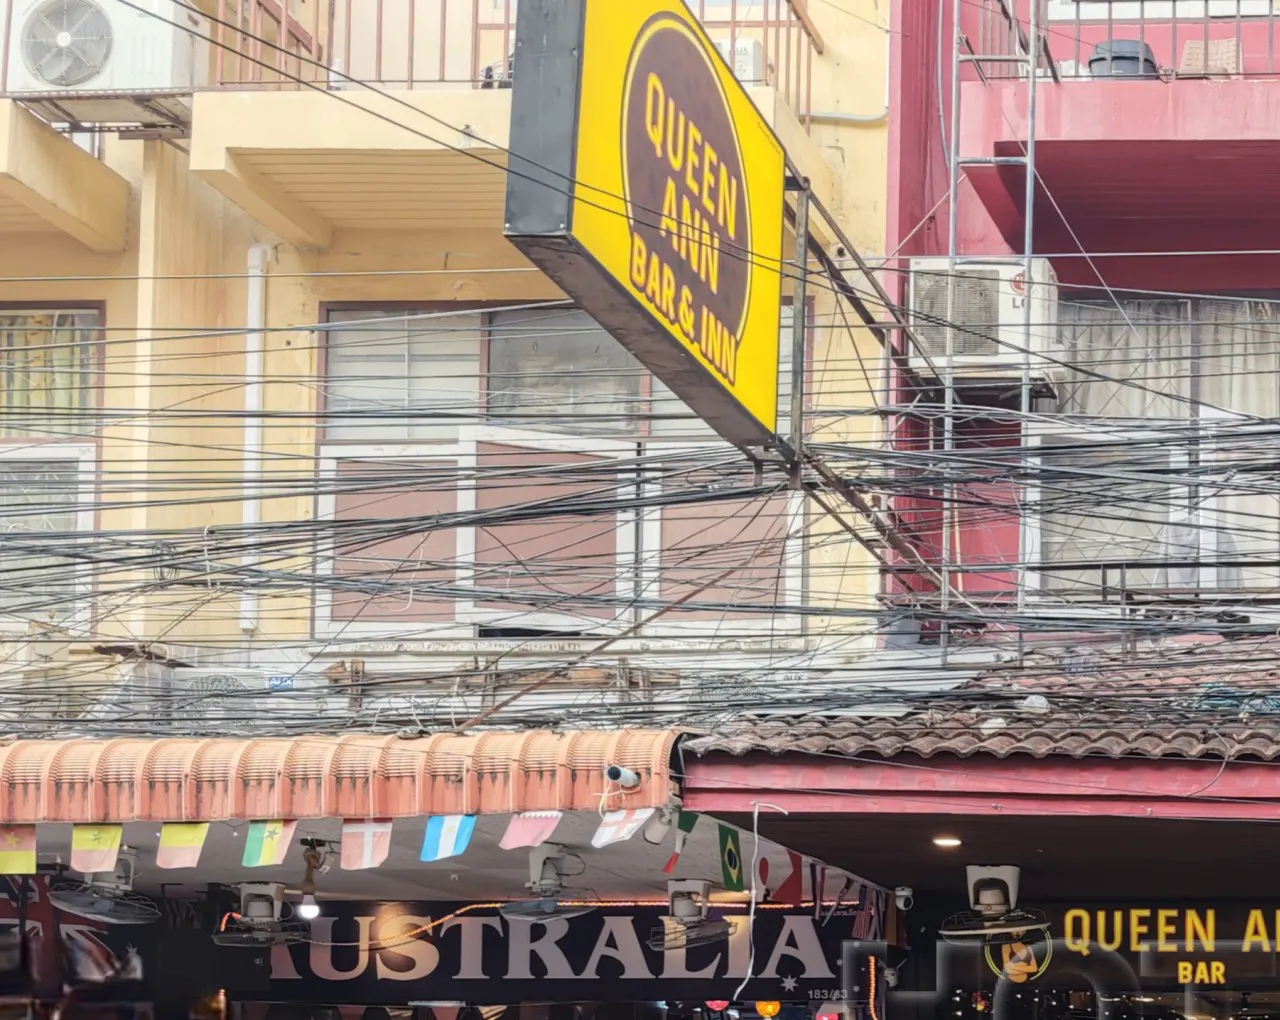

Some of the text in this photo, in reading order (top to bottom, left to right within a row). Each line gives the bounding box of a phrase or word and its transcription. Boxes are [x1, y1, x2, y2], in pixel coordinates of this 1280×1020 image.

[645, 72, 737, 241] QUEEN
[659, 176, 720, 295] ANN
[630, 232, 677, 326] BAR
[699, 305, 737, 387] INN
[1064, 908, 1217, 956] QUEEN
[1177, 961, 1226, 985] BAR
